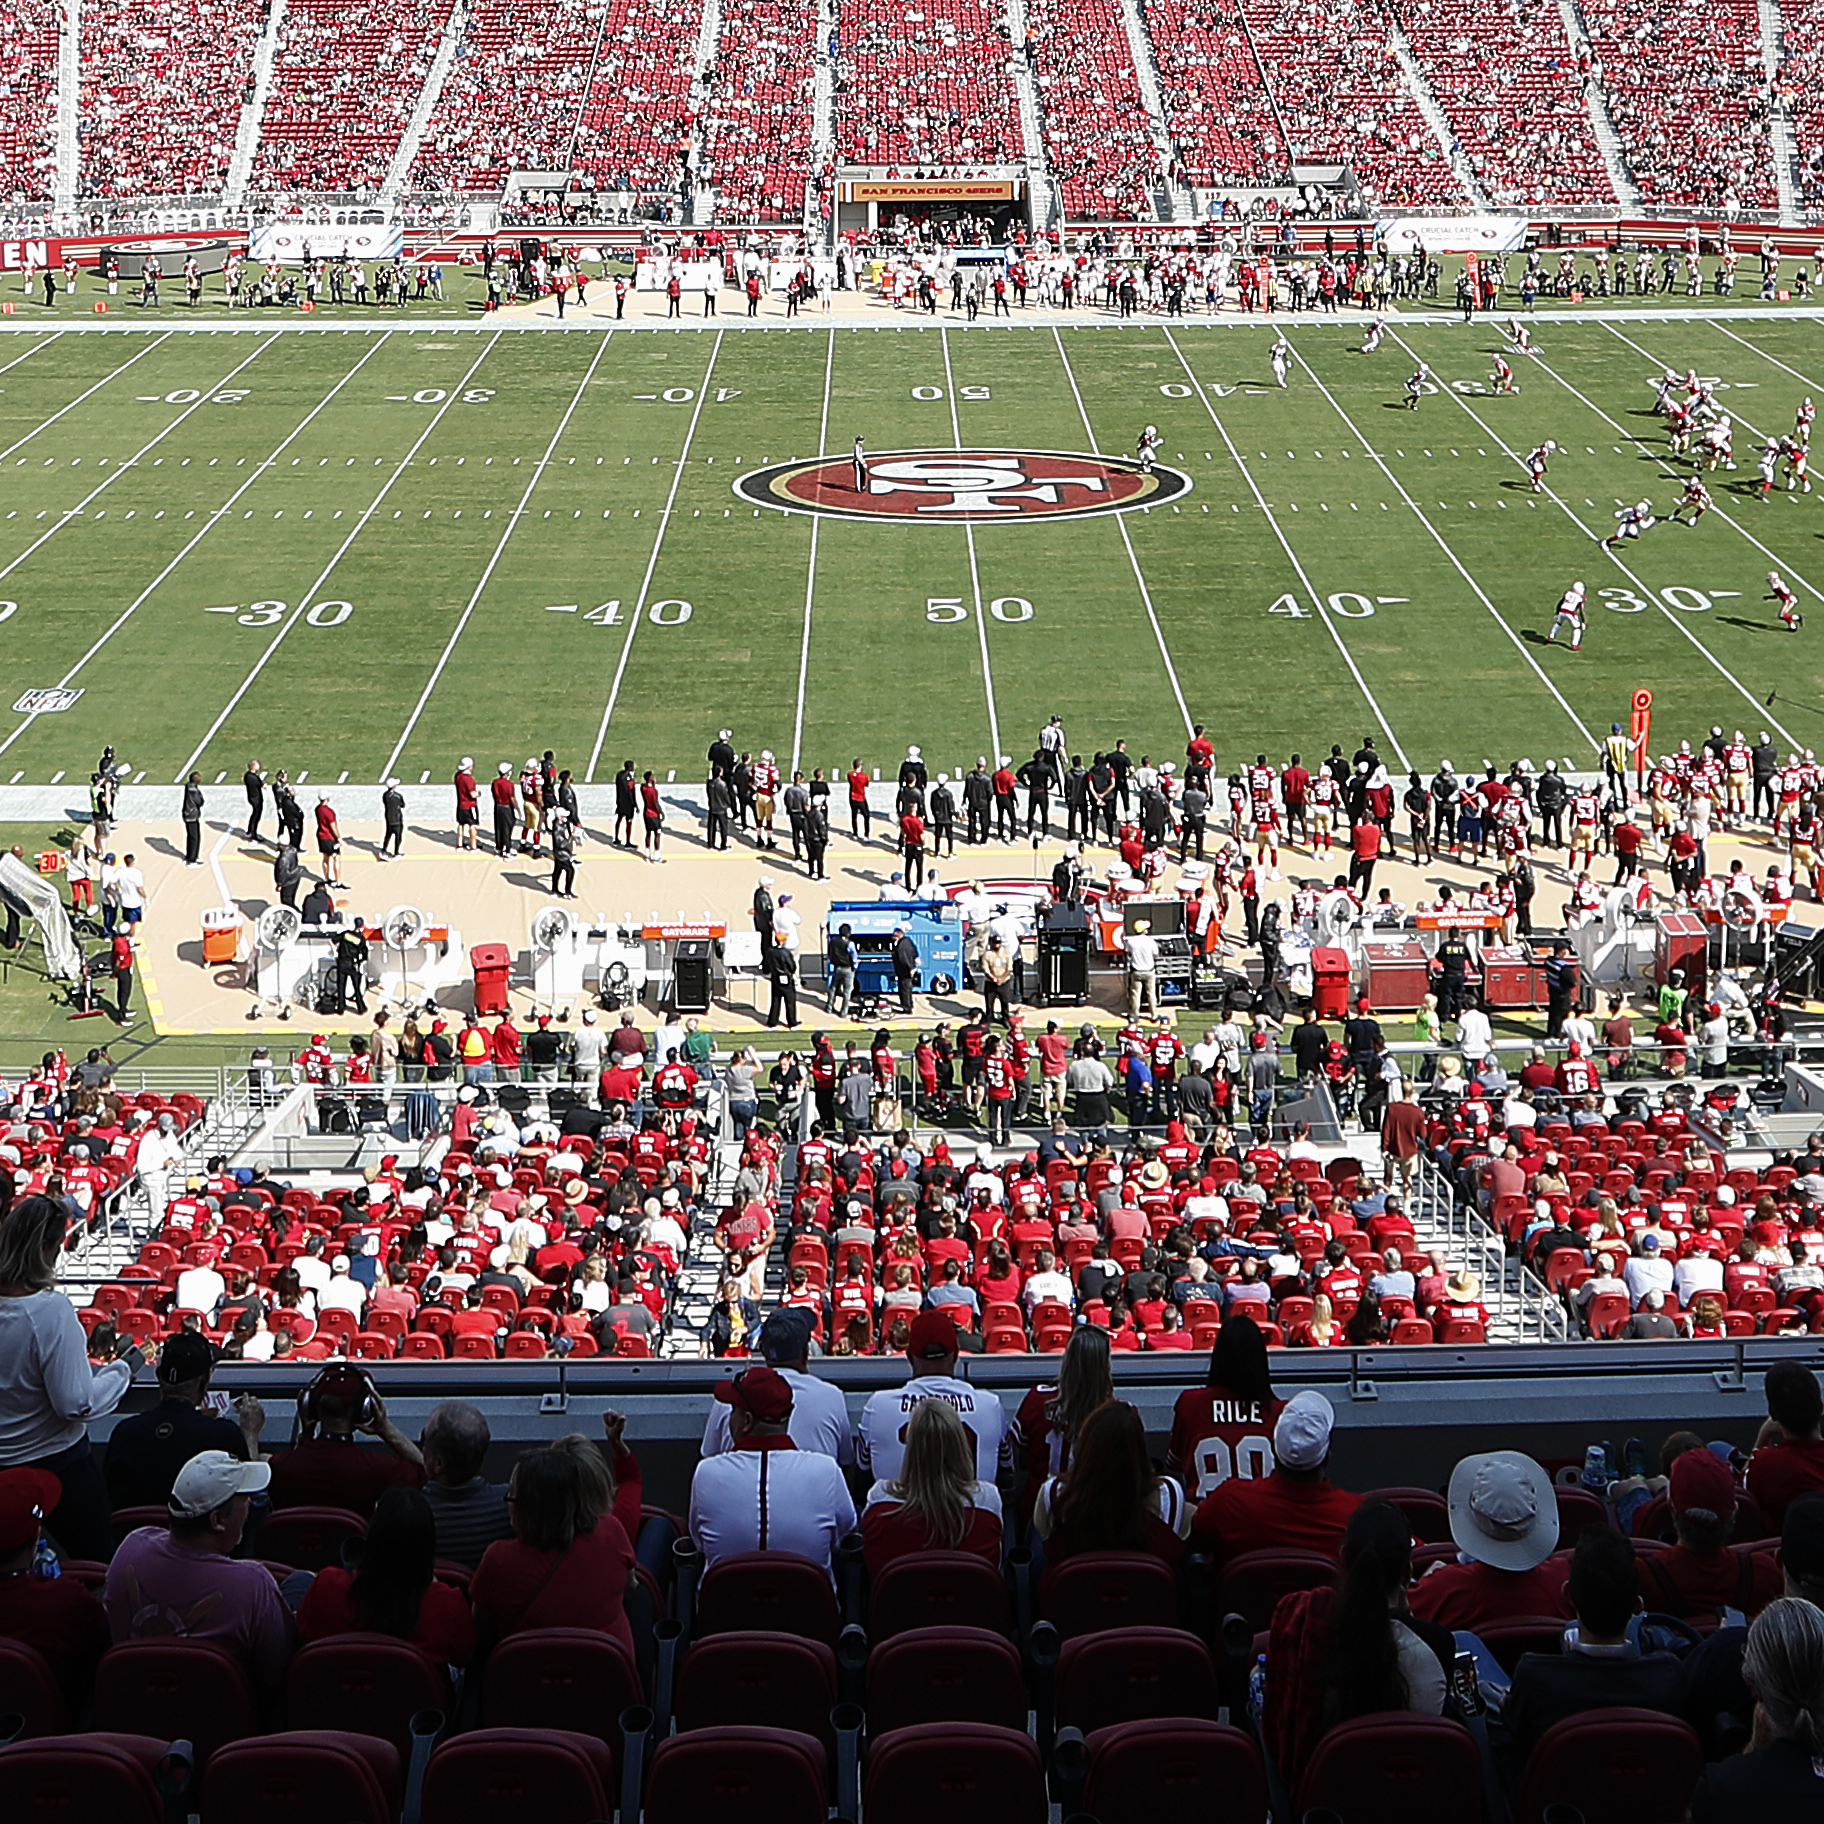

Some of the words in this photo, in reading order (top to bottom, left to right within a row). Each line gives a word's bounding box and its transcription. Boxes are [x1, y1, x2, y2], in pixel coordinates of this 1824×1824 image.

[892, 187, 962, 195] FRANCISCO
[1205, 192, 1221, 200] 117
[163, 389, 253, 405] 20
[409, 388, 496, 404] 30
[911, 386, 992, 401] 50
[1267, 592, 1376, 619] 40
[1596, 587, 1715, 613] 30
[235, 600, 354, 627] 30
[581, 599, 693, 626] 40
[925, 597, 1035, 623] 50
[661, 927, 709, 936] GATORADE
[1438, 918, 1485, 926] GATORADE
[1213, 1400, 1263, 1423] RICE
[1194, 1435, 1275, 1499] 80
